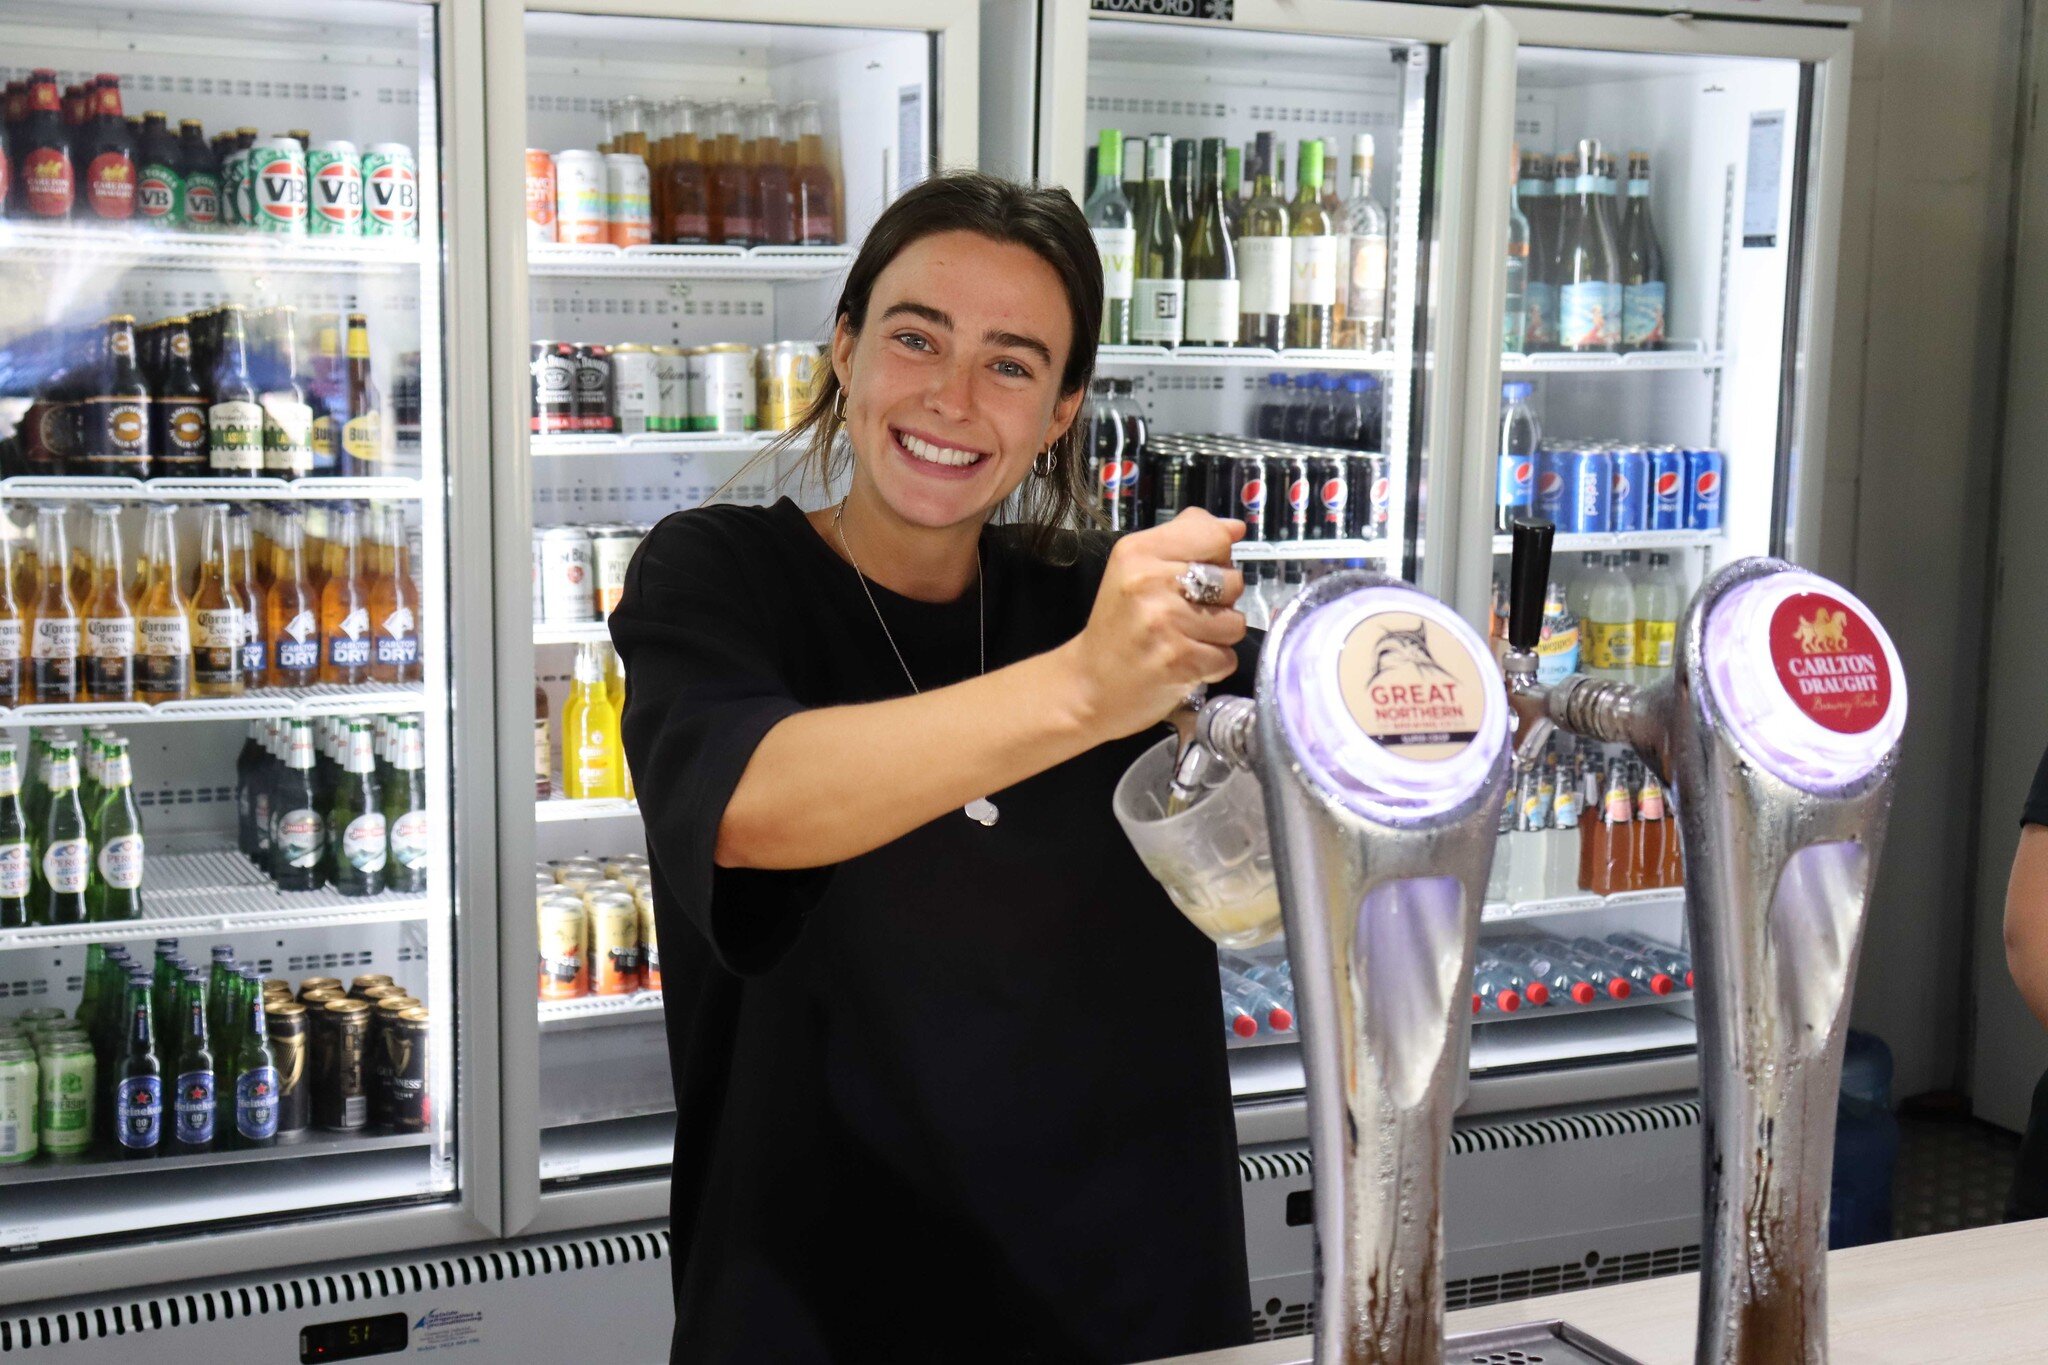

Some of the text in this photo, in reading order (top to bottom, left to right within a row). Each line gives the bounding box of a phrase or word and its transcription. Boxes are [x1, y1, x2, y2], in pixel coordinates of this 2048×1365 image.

[262, 176, 306, 202] VB
[318, 178, 360, 205] VB
[371, 180, 414, 207] VB
[140, 191, 169, 206] VB
[188, 198, 218, 213] VB
[88, 621, 134, 635] Corona
[139, 618, 181, 633] Corona
[280, 652, 318, 666] DRY
[334, 649, 370, 663] DRY
[379, 649, 417, 662] DRY
[1788, 654, 1876, 677] CARLTON
[1799, 674, 1878, 695] DRAUGHT
[1372, 684, 1456, 705] GREAT
[1376, 706, 1464, 720] NORTHERN
[118, 1105, 162, 1117] Heineken
[174, 1101, 217, 1112] Heineken
